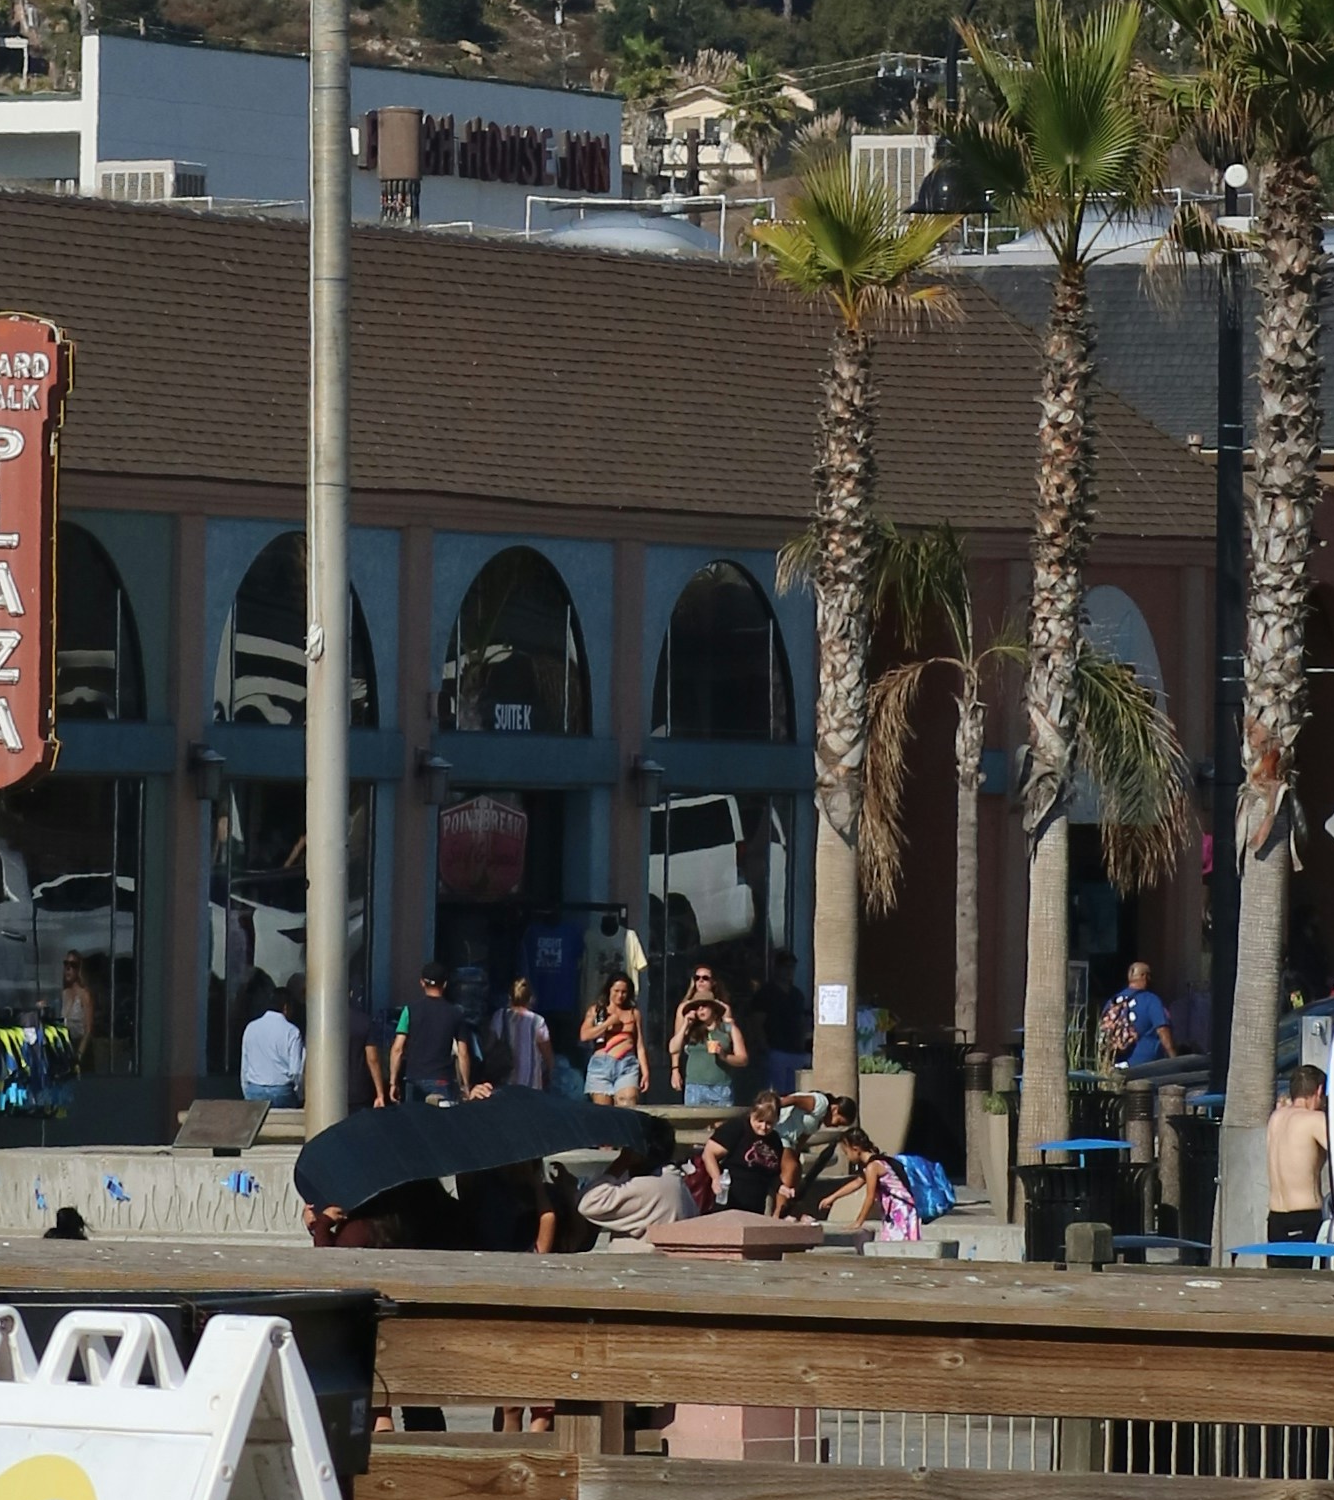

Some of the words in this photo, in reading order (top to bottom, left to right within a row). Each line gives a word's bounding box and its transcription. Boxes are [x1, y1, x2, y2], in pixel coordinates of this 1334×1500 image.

[459, 116, 555, 186] HOUSE
[556, 130, 610, 192] INN
[495, 704, 522, 730] SUITE
[523, 705, 532, 730] K
